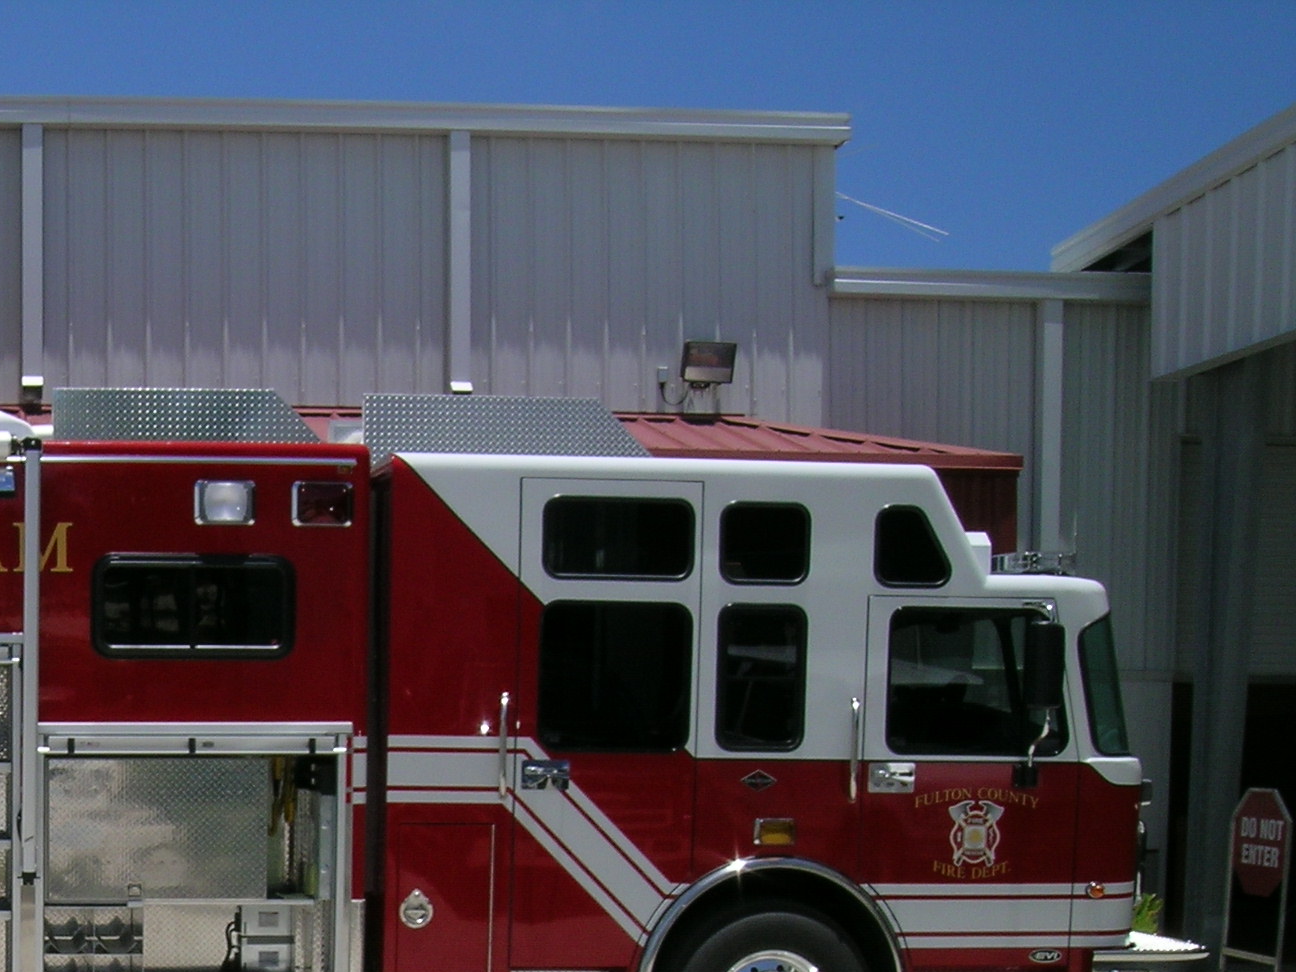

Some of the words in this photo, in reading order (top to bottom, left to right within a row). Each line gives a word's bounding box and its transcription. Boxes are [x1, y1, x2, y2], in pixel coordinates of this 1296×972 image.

[914, 788, 972, 808] FULTON
[977, 787, 1039, 809] COUNTY
[1241, 816, 1257, 838] DO
[1259, 818, 1284, 841] NOT
[1241, 843, 1280, 868] ENTER
[932, 860, 965, 879] FIRE
[971, 861, 1012, 879] DEPT.
